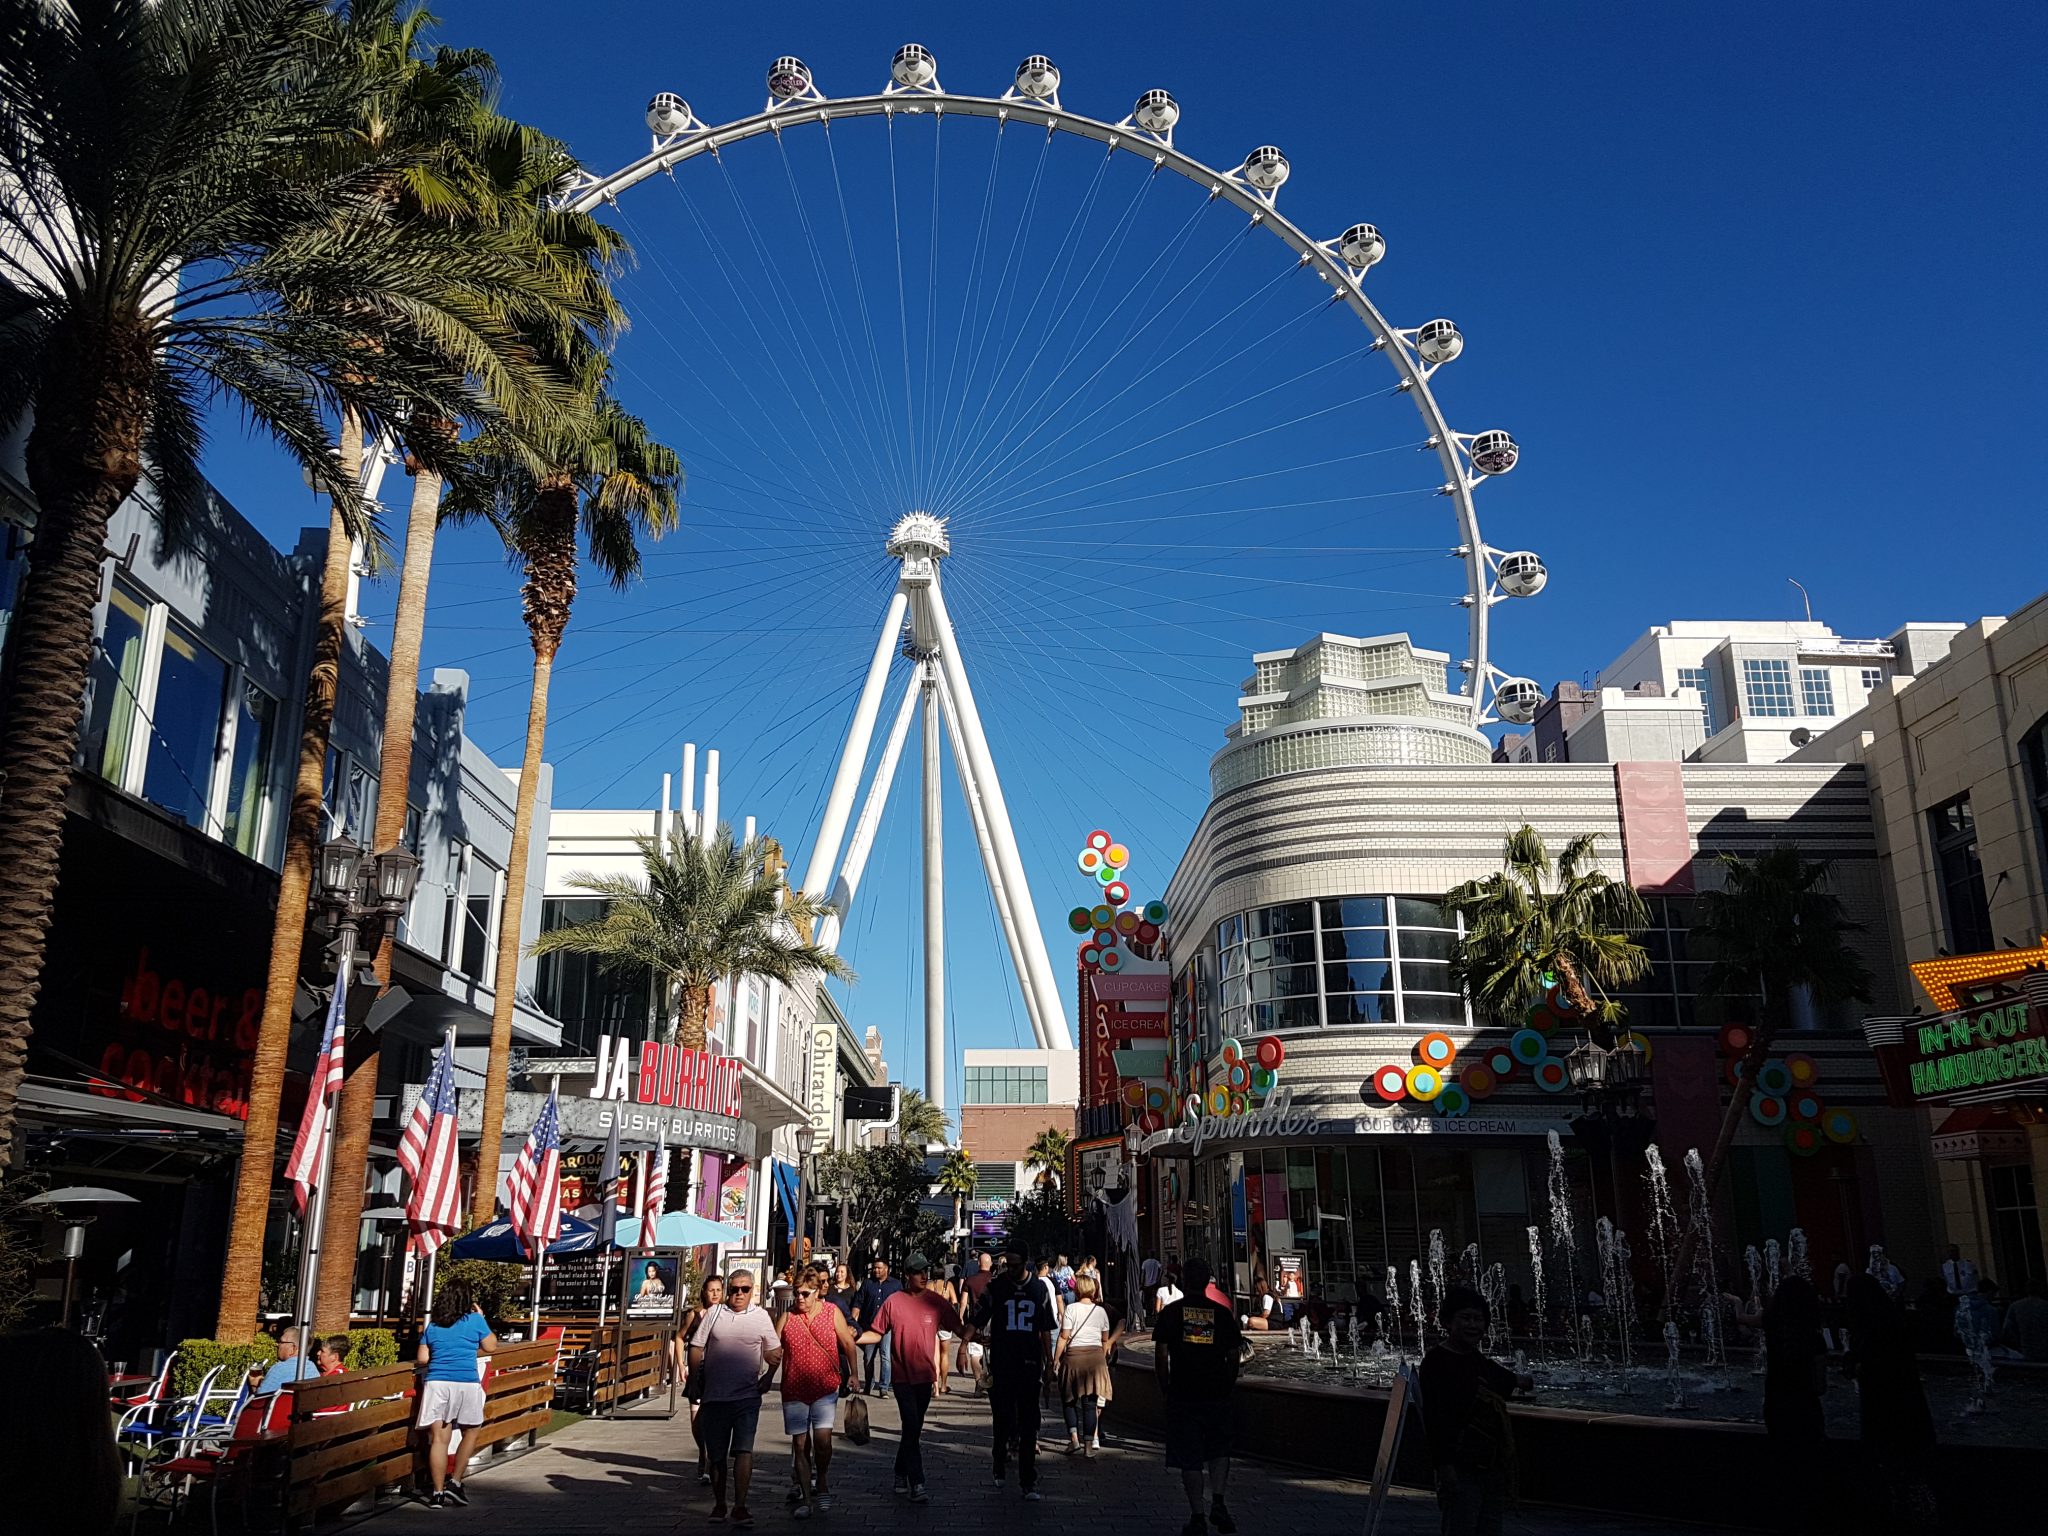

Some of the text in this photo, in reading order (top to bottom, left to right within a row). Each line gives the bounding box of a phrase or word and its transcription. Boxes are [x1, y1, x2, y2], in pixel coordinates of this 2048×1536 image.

[1104, 982, 1169, 992] CUPCAKES
[1111, 1019, 1129, 1030] ICE
[1918, 1003, 2029, 1055] IN-N-OUT
[97, 1042, 251, 1120] cocktai
[1909, 1036, 2048, 1095] HAMBURGERS
[811, 1029, 833, 1148] Ghirardelli
[672, 1119, 736, 1142] BURRITOS
[1179, 1086, 1333, 1156] Sprinkles
[1361, 1119, 1440, 1132] CUPCAKES
[1444, 1120, 1466, 1132] ICE
[1468, 1120, 1517, 1132] CREAM
[559, 1153, 631, 1171] ROOKN
[1004, 1298, 1036, 1332] 12
